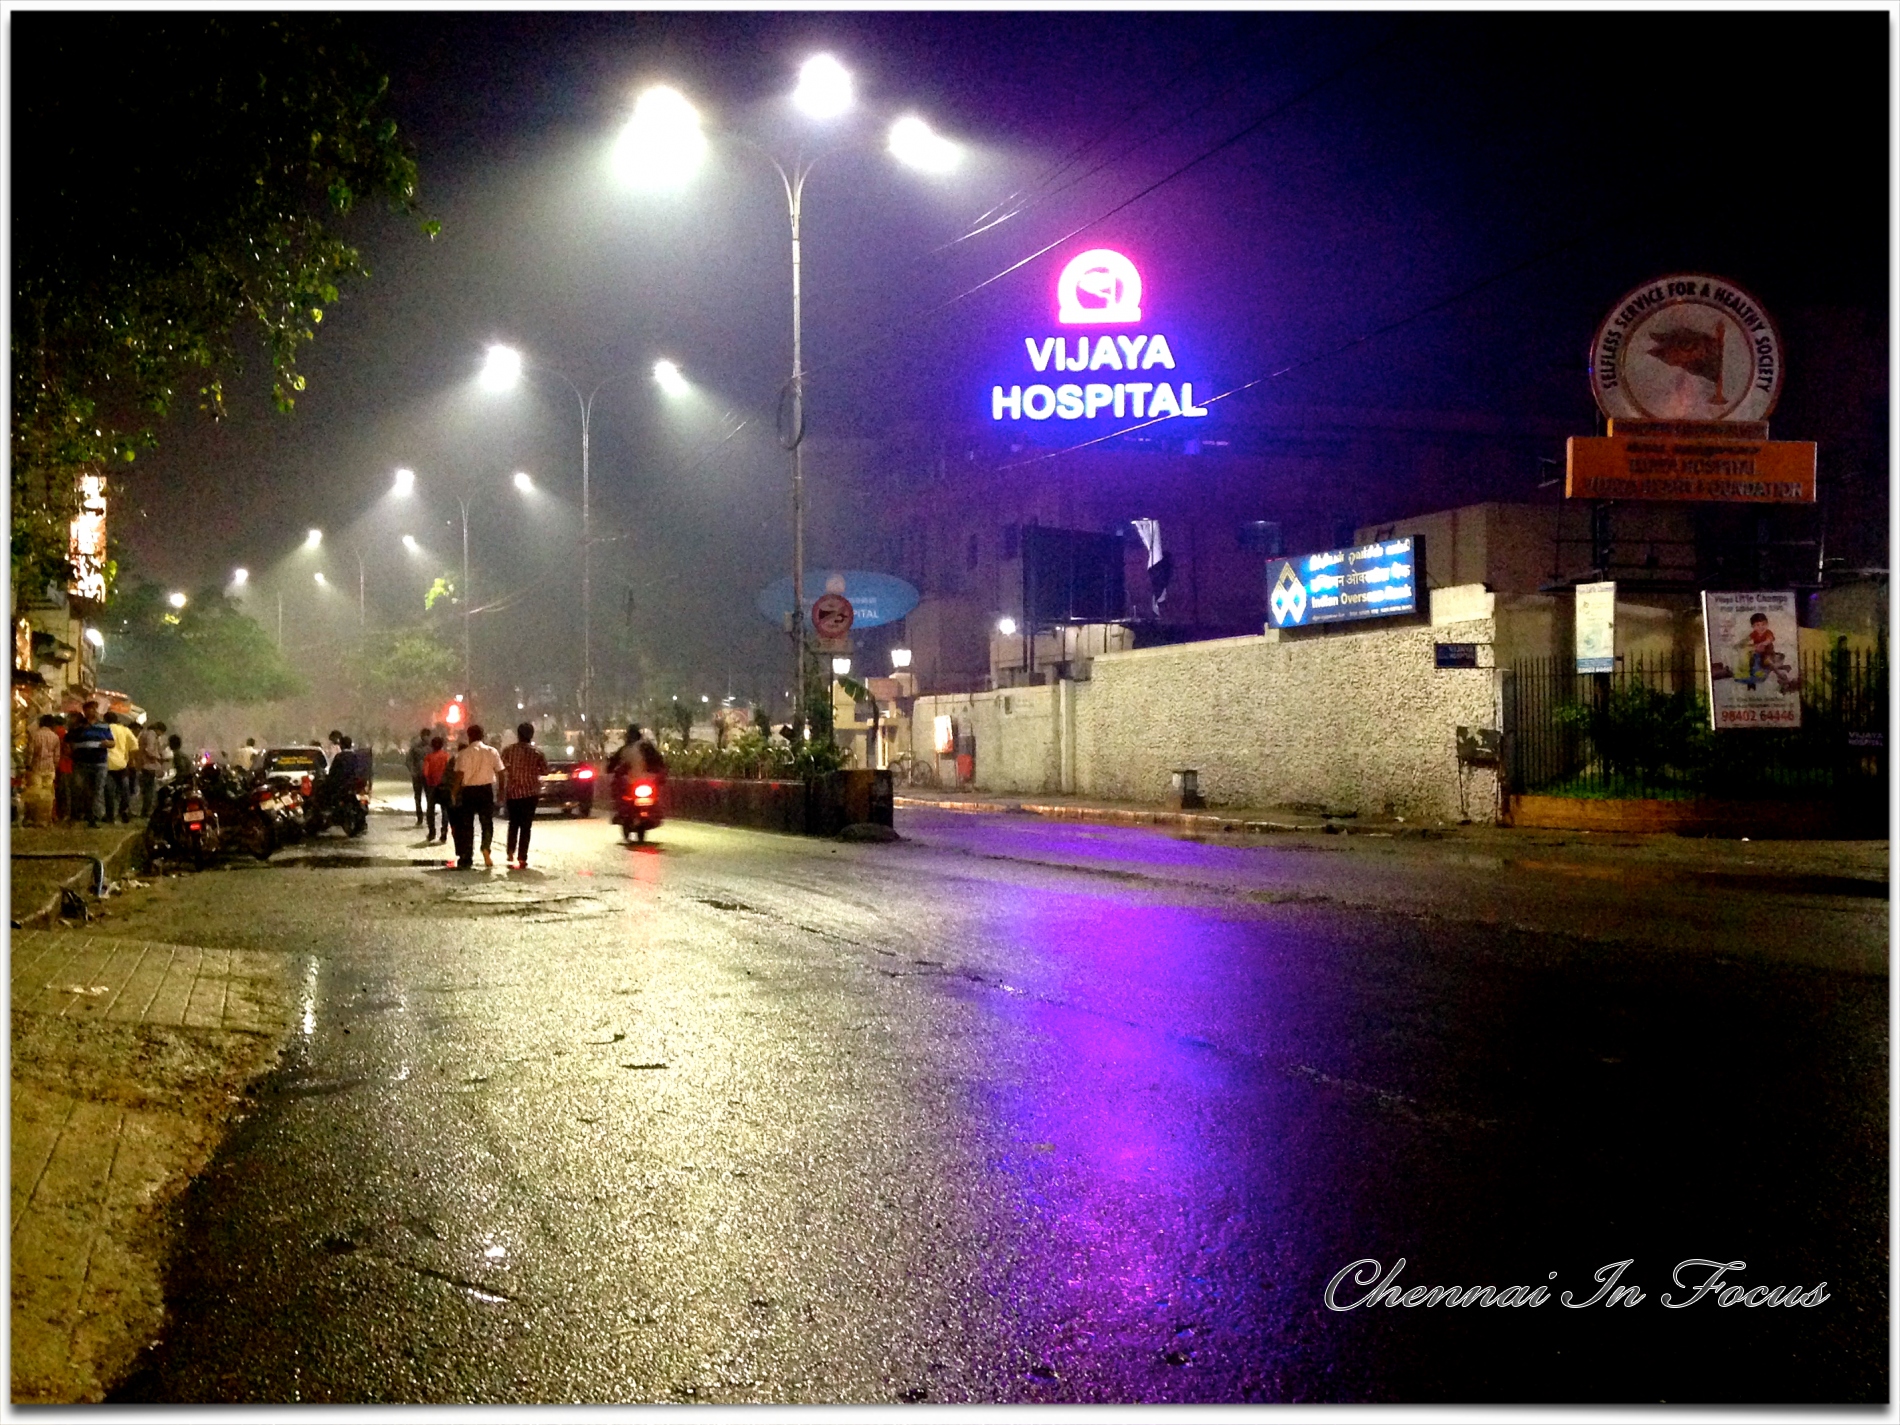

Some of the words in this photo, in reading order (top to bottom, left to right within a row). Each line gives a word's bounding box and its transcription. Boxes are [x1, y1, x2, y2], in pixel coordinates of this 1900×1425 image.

[1025, 334, 1176, 372] VIJAYA
[1601, 330, 1622, 389] SELFLESS
[1616, 286, 1665, 331] SERVICE
[1667, 281, 1696, 297] FOR
[1700, 284, 1712, 298] A
[1713, 286, 1765, 333] HEALTHY
[1755, 336, 1774, 392] SOCIETY
[992, 382, 1208, 420] HOSPITAL
[1311, 594, 1339, 609] Indian
[1721, 710, 1757, 722] 98402
